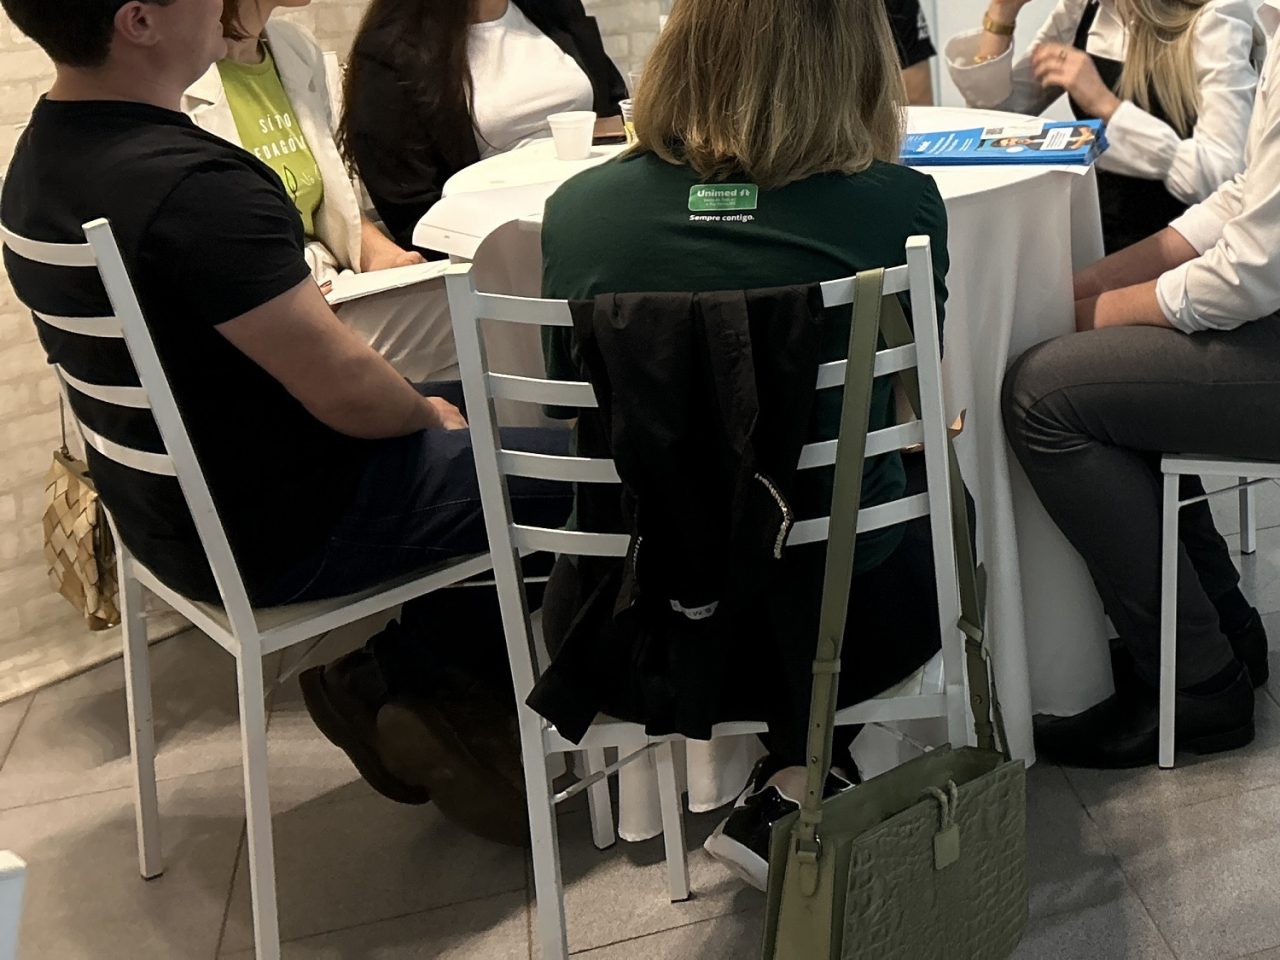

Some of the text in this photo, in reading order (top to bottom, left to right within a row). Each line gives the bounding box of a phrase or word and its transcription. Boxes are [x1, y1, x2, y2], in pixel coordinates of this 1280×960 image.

[697, 189, 737, 197] Unimed
[689, 213, 755, 223] Sempre contigo.
